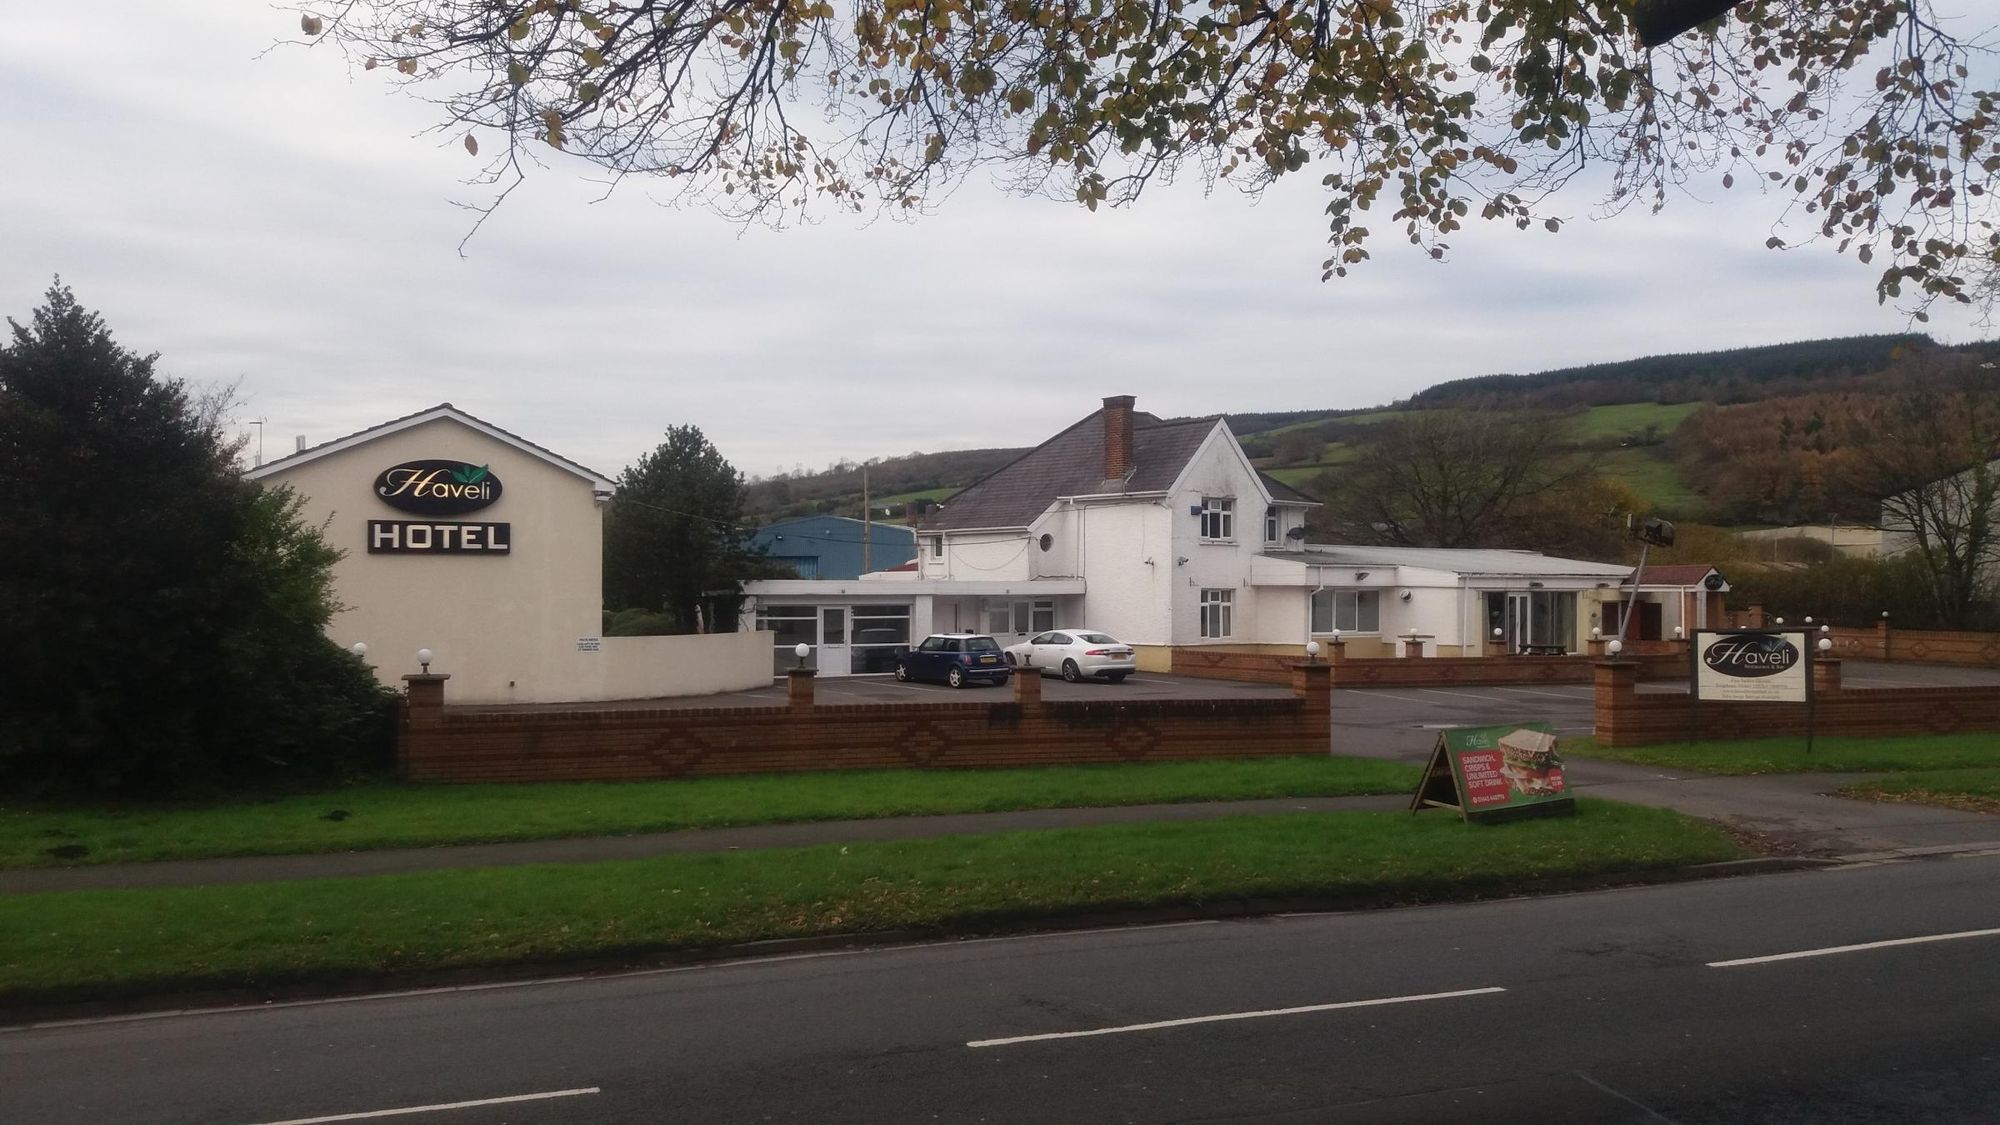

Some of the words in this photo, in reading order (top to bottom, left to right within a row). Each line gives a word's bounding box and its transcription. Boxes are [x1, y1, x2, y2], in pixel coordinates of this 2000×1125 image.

[379, 468, 491, 500] Haveli
[373, 523, 508, 550] HOTEL
[1706, 641, 1790, 665] Haveli
[1464, 763, 1485, 773] CRISPS
[1466, 770, 1498, 780] UNLIMITED
[1468, 779, 1484, 789] SOFT
